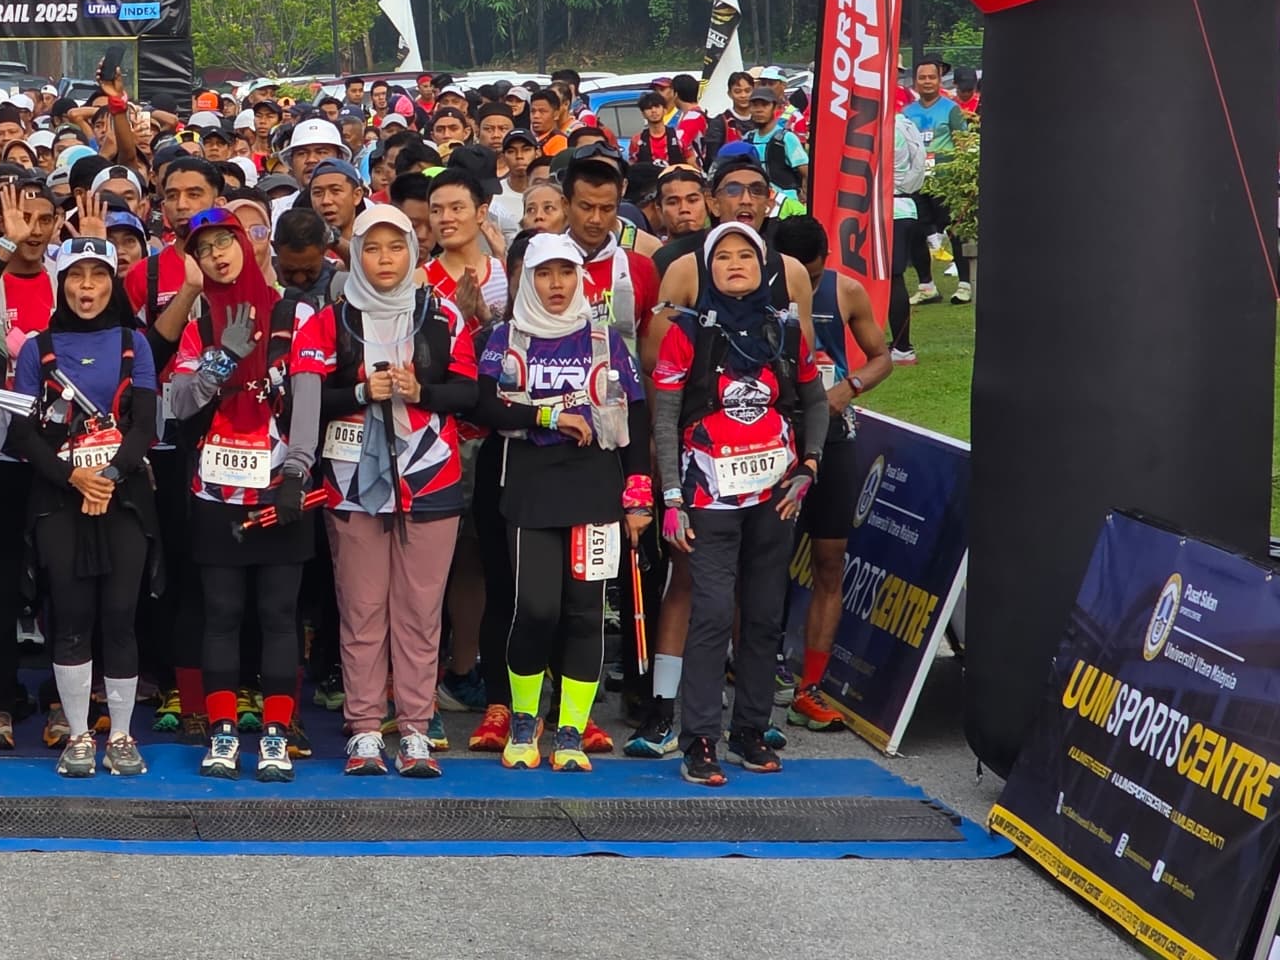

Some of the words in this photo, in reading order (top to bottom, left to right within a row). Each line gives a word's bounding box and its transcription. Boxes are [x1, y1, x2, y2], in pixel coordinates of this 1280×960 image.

[35, 3, 78, 23] 2025
[88, 4, 117, 14] UTMB
[124, 6, 157, 16] INDEX
[526, 356, 592, 366] AKAWAN
[335, 427, 363, 444] D056
[215, 452, 258, 470] F0833
[731, 456, 776, 476] F0007
[1164, 641, 1197, 669] Universiti
[1194, 656, 1212, 677] Utara
[1210, 663, 1237, 690] Malaysia
[1062, 659, 1280, 821] UUMSPORTSCENTRE
